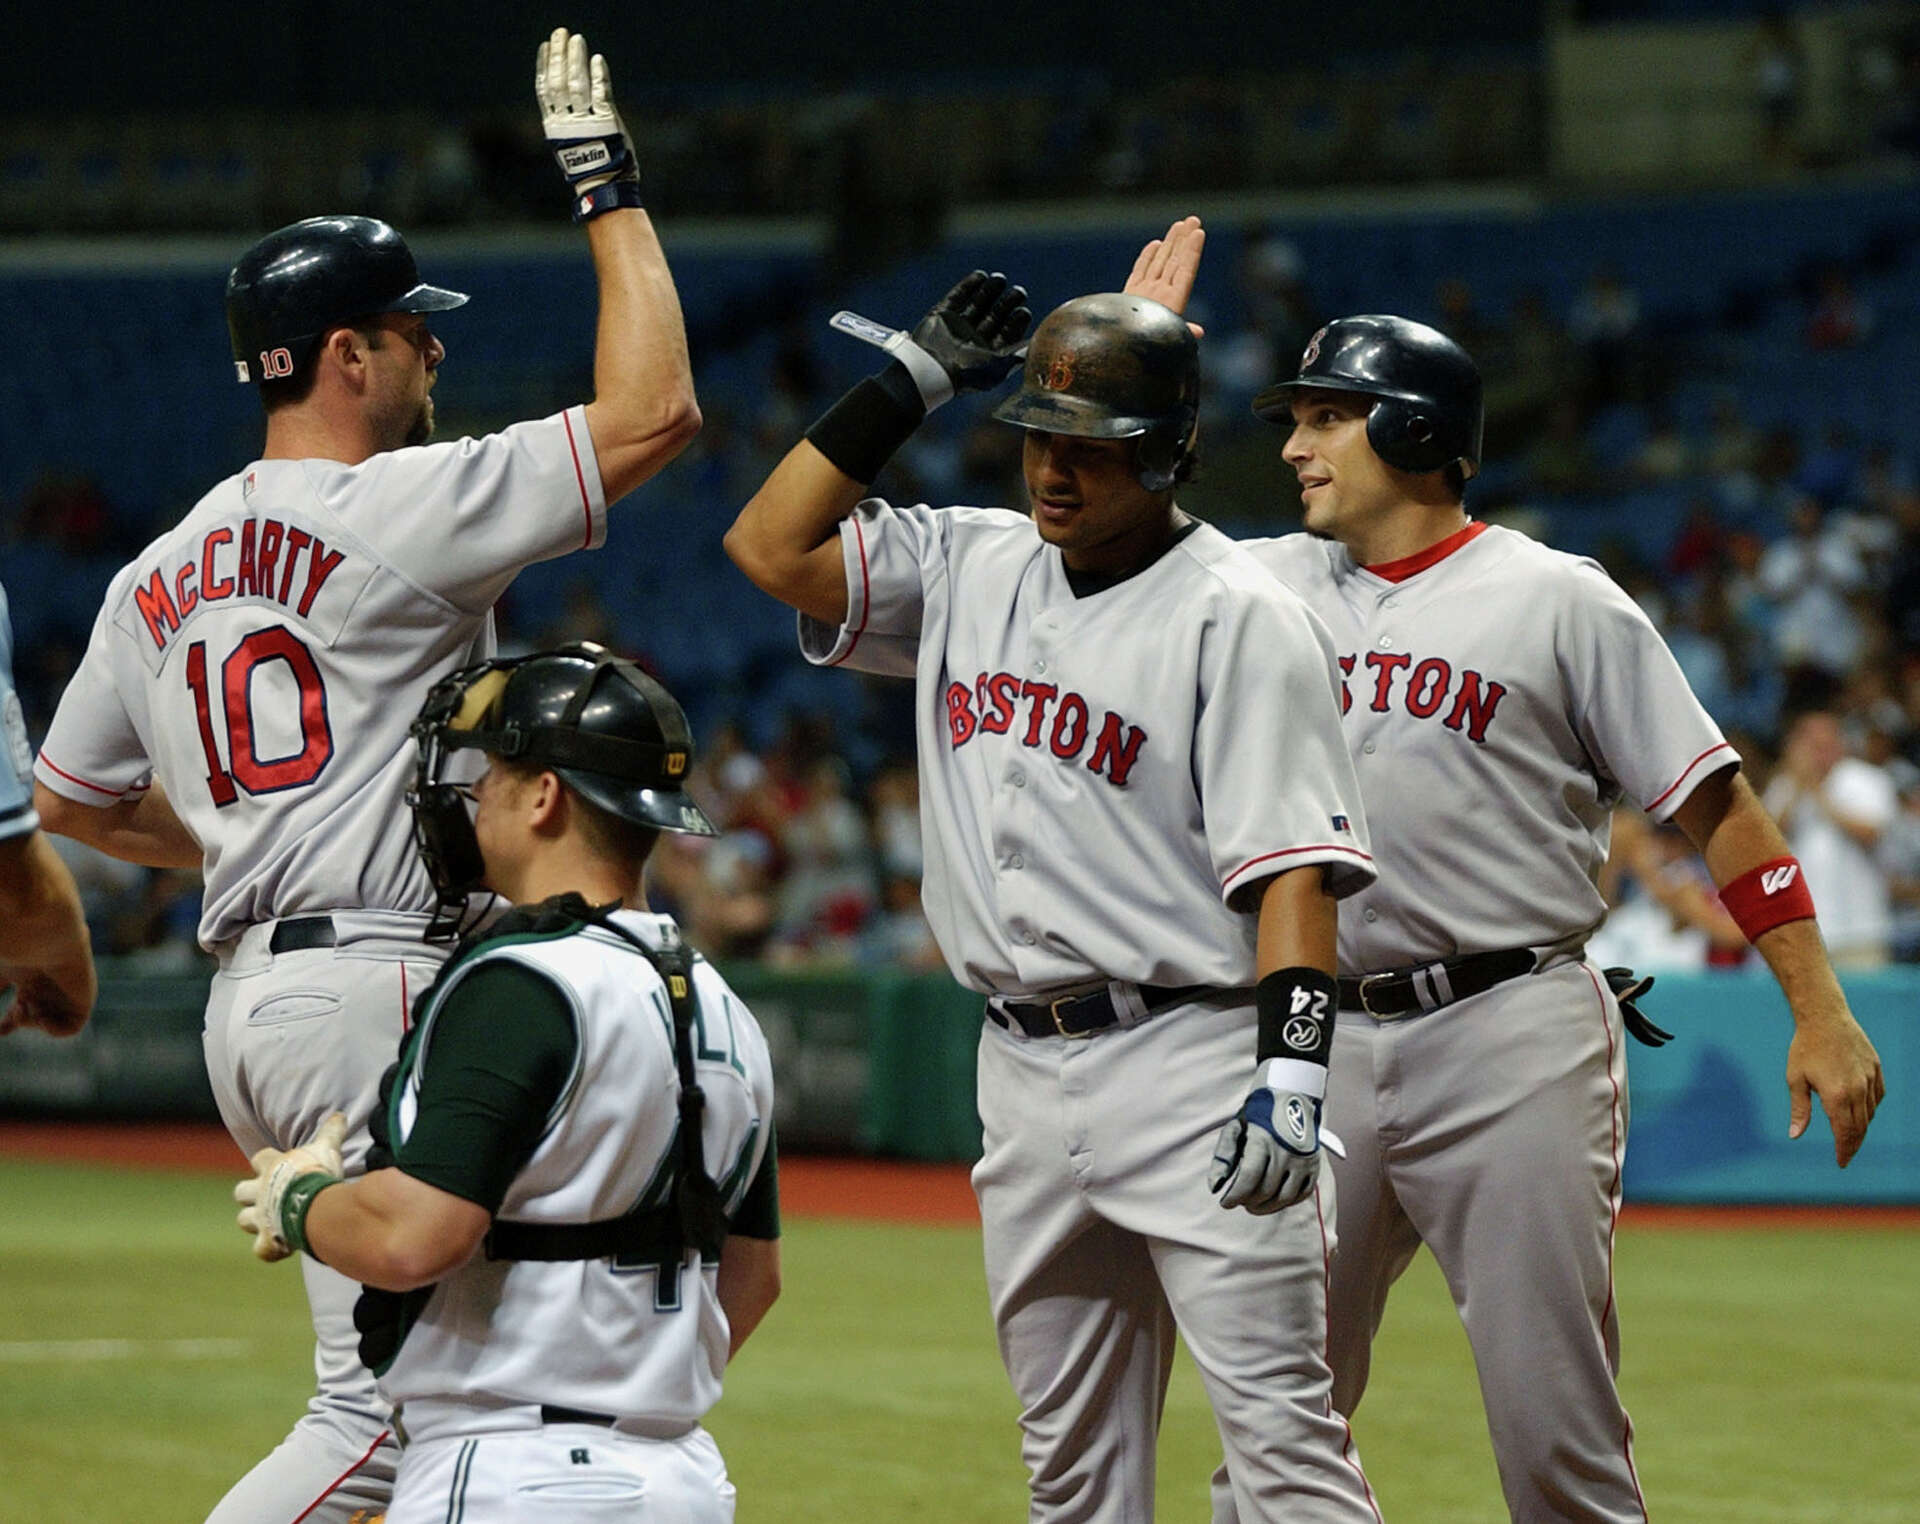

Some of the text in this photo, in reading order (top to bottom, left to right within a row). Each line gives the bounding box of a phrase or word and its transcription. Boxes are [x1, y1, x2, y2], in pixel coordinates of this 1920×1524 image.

[260, 347, 294, 380] 10
[186, 624, 335, 809] 10
[1289, 985, 1329, 1021] 24
